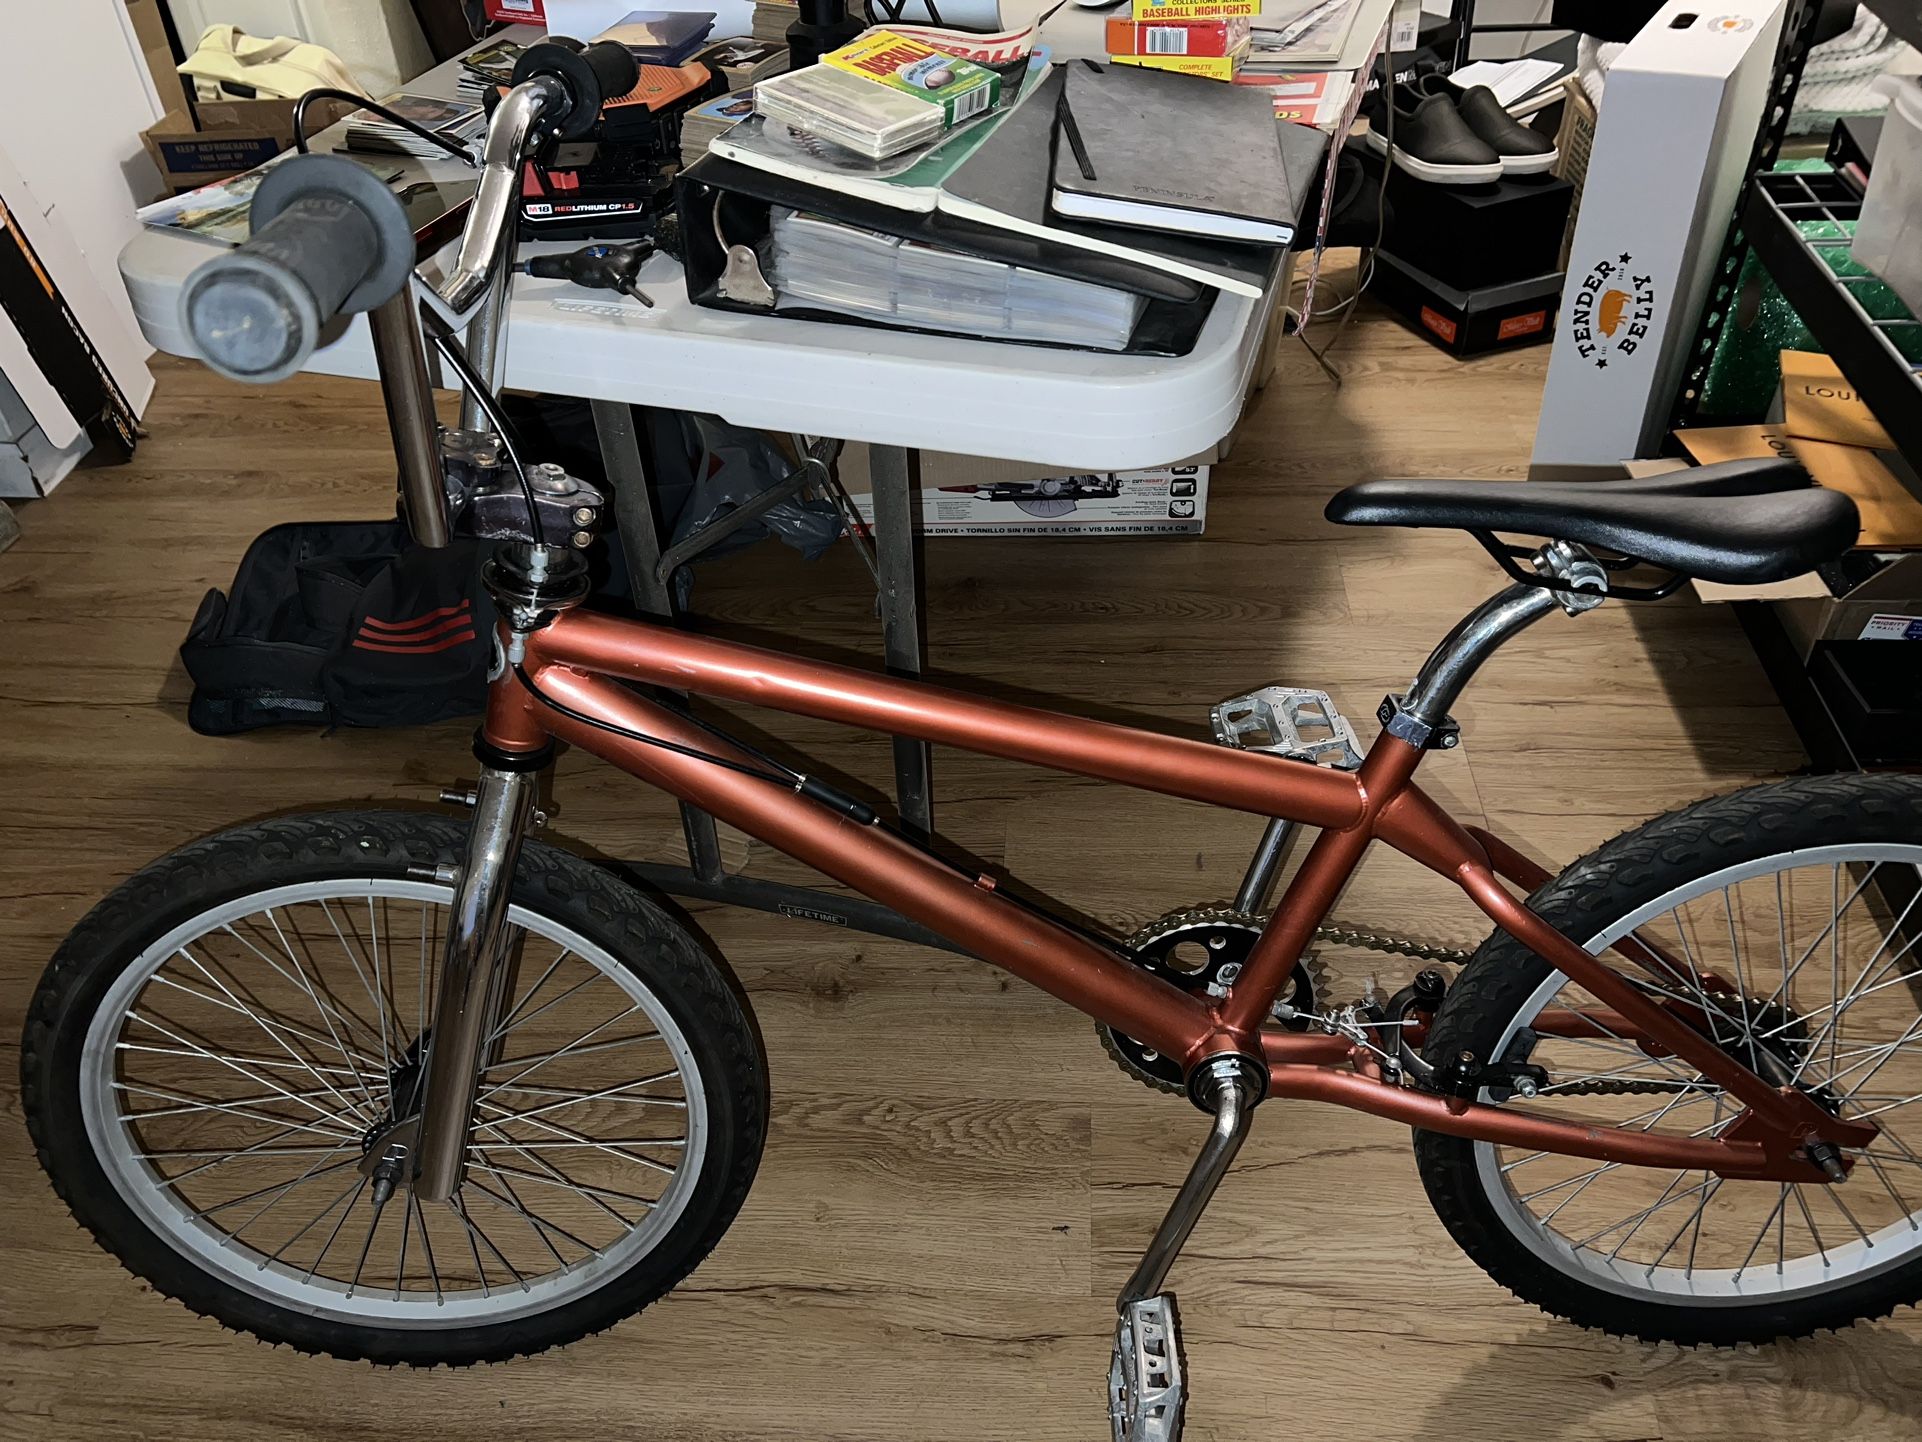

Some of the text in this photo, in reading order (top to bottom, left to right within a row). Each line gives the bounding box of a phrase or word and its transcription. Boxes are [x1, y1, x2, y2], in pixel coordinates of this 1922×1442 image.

[1142, 4, 1251, 18] BASEBALL HIGHLIGHTS
[529, 205, 550, 213] M18
[555, 204, 606, 212] REDLITHIUM
[1573, 261, 1616, 358] TENDER
[1617, 275, 1654, 355] BELLY
[61, 306, 90, 354] BACON
[966, 526, 1005, 534] TORNILLO
[787, 907, 839, 923] LIFETIME
